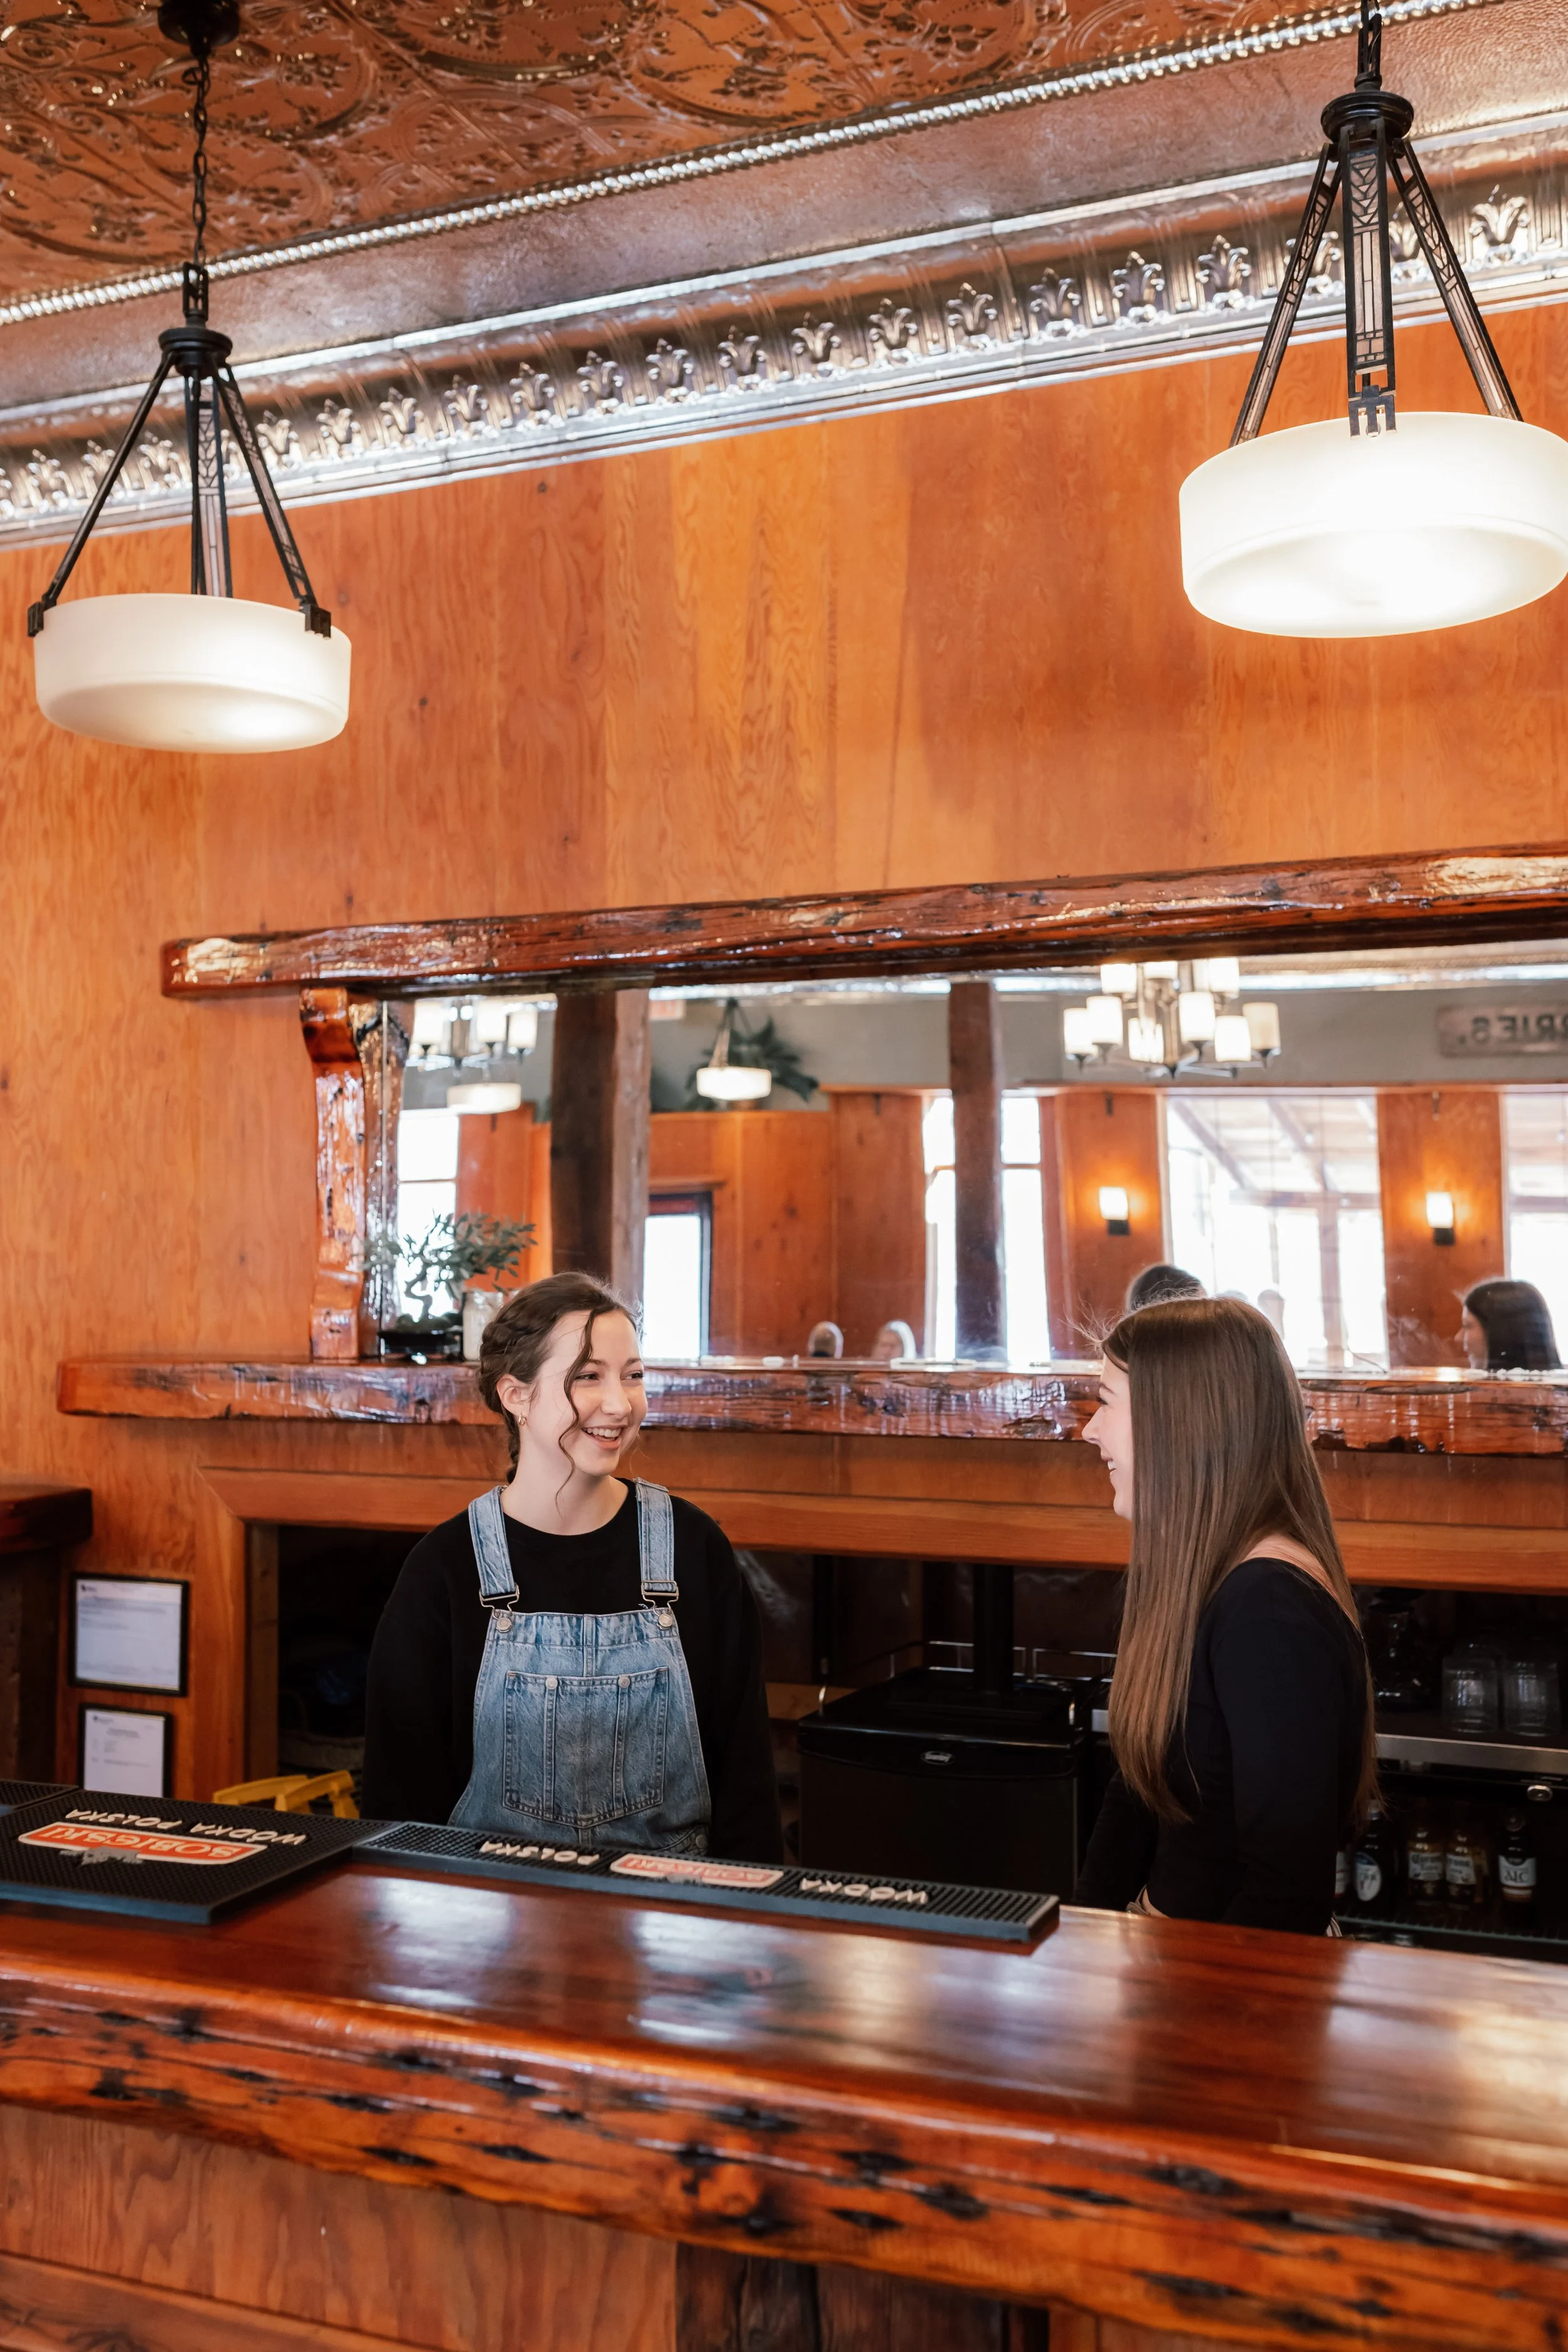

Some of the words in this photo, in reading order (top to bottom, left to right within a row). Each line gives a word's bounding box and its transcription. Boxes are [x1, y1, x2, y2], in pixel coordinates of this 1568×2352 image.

[65, 1809, 183, 1830] POLSKA
[39, 1826, 242, 1858] SOBIESKI
[479, 1841, 600, 1865] POLSKA
